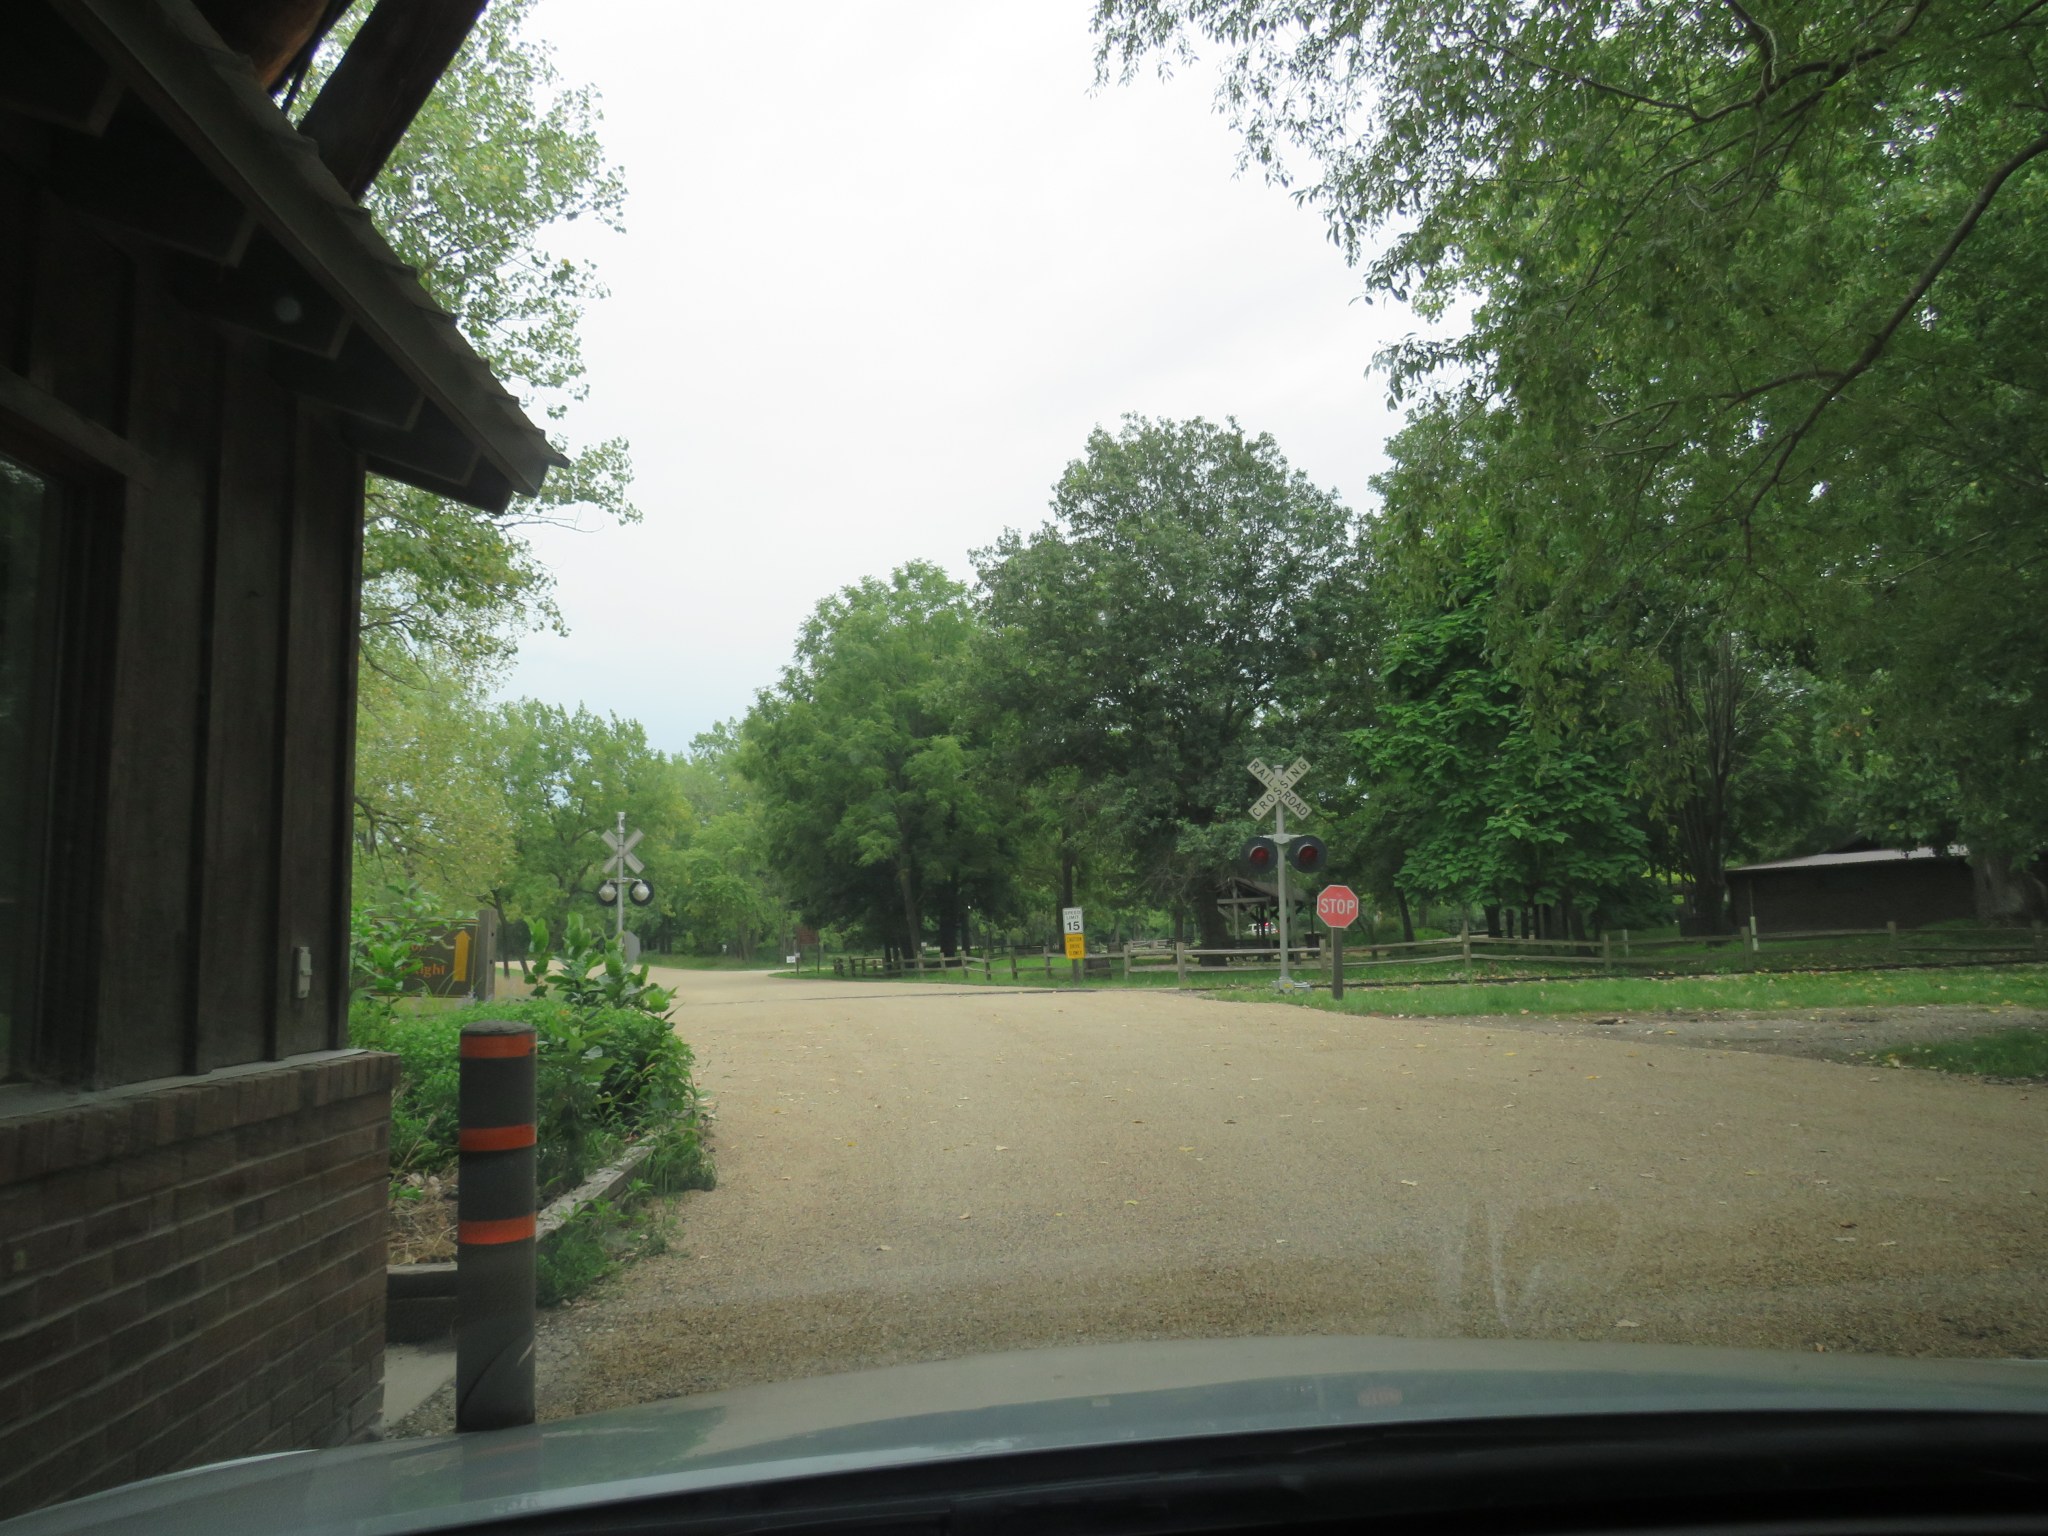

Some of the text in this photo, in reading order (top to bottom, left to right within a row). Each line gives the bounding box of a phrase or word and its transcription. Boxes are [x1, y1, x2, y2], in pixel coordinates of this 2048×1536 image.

[1250, 761, 1308, 816] RAIL ROAD
[1252, 761, 1307, 817] CROSSING
[1320, 898, 1355, 915] STOP
[1066, 921, 1080, 930] 15
